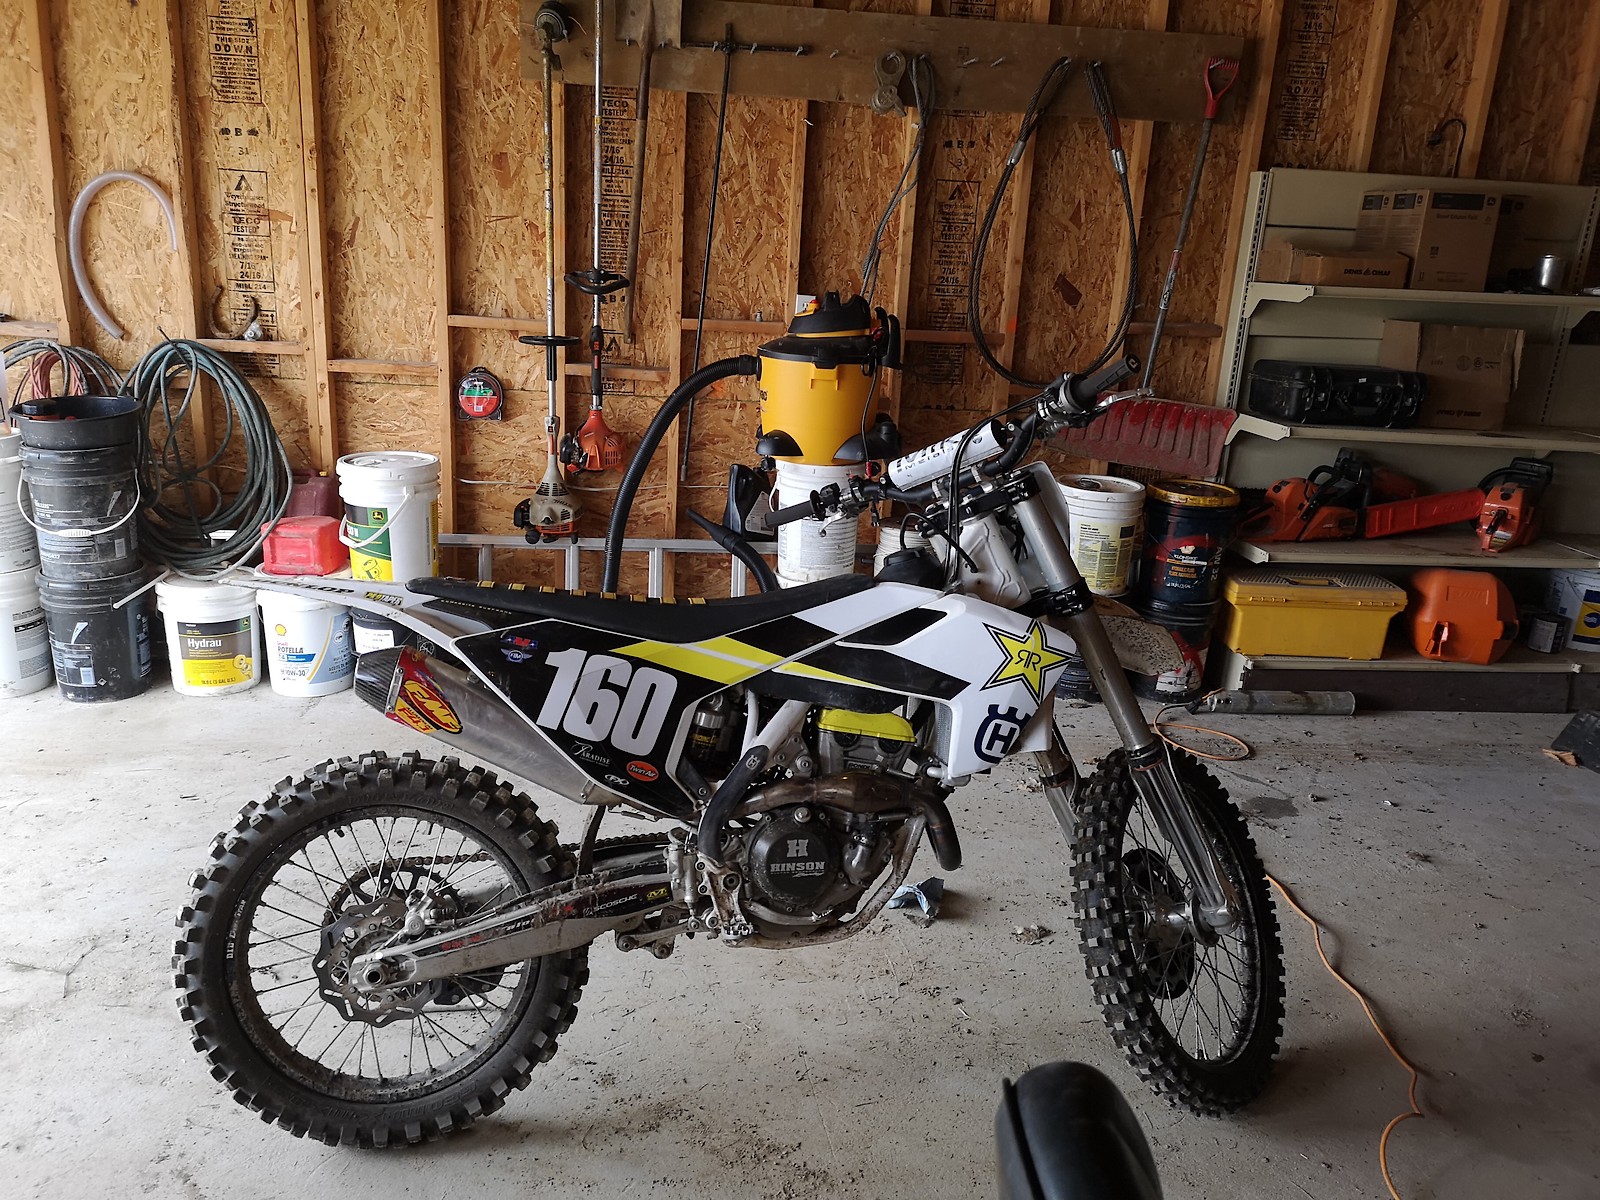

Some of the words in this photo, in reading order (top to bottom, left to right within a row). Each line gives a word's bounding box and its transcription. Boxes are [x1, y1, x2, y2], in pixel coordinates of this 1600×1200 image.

[215, 44, 253, 54] DOWN
[1286, 86, 1319, 95] DOWN
[604, 156, 624, 164] 24/16
[232, 216, 260, 225] TECO
[240, 271, 261, 279] 24/16
[940, 276, 960, 284] 24/16
[1213, 546, 1223, 565] AW
[1210, 568, 1219, 581] 32
[187, 638, 222, 649] Hydrau
[404, 681, 461, 731] FMF
[536, 648, 677, 756] 160
[629, 764, 646, 775] Twin
[644, 769, 657, 778] Air
[786, 839, 809, 858] H
[770, 861, 825, 872] HINSON
